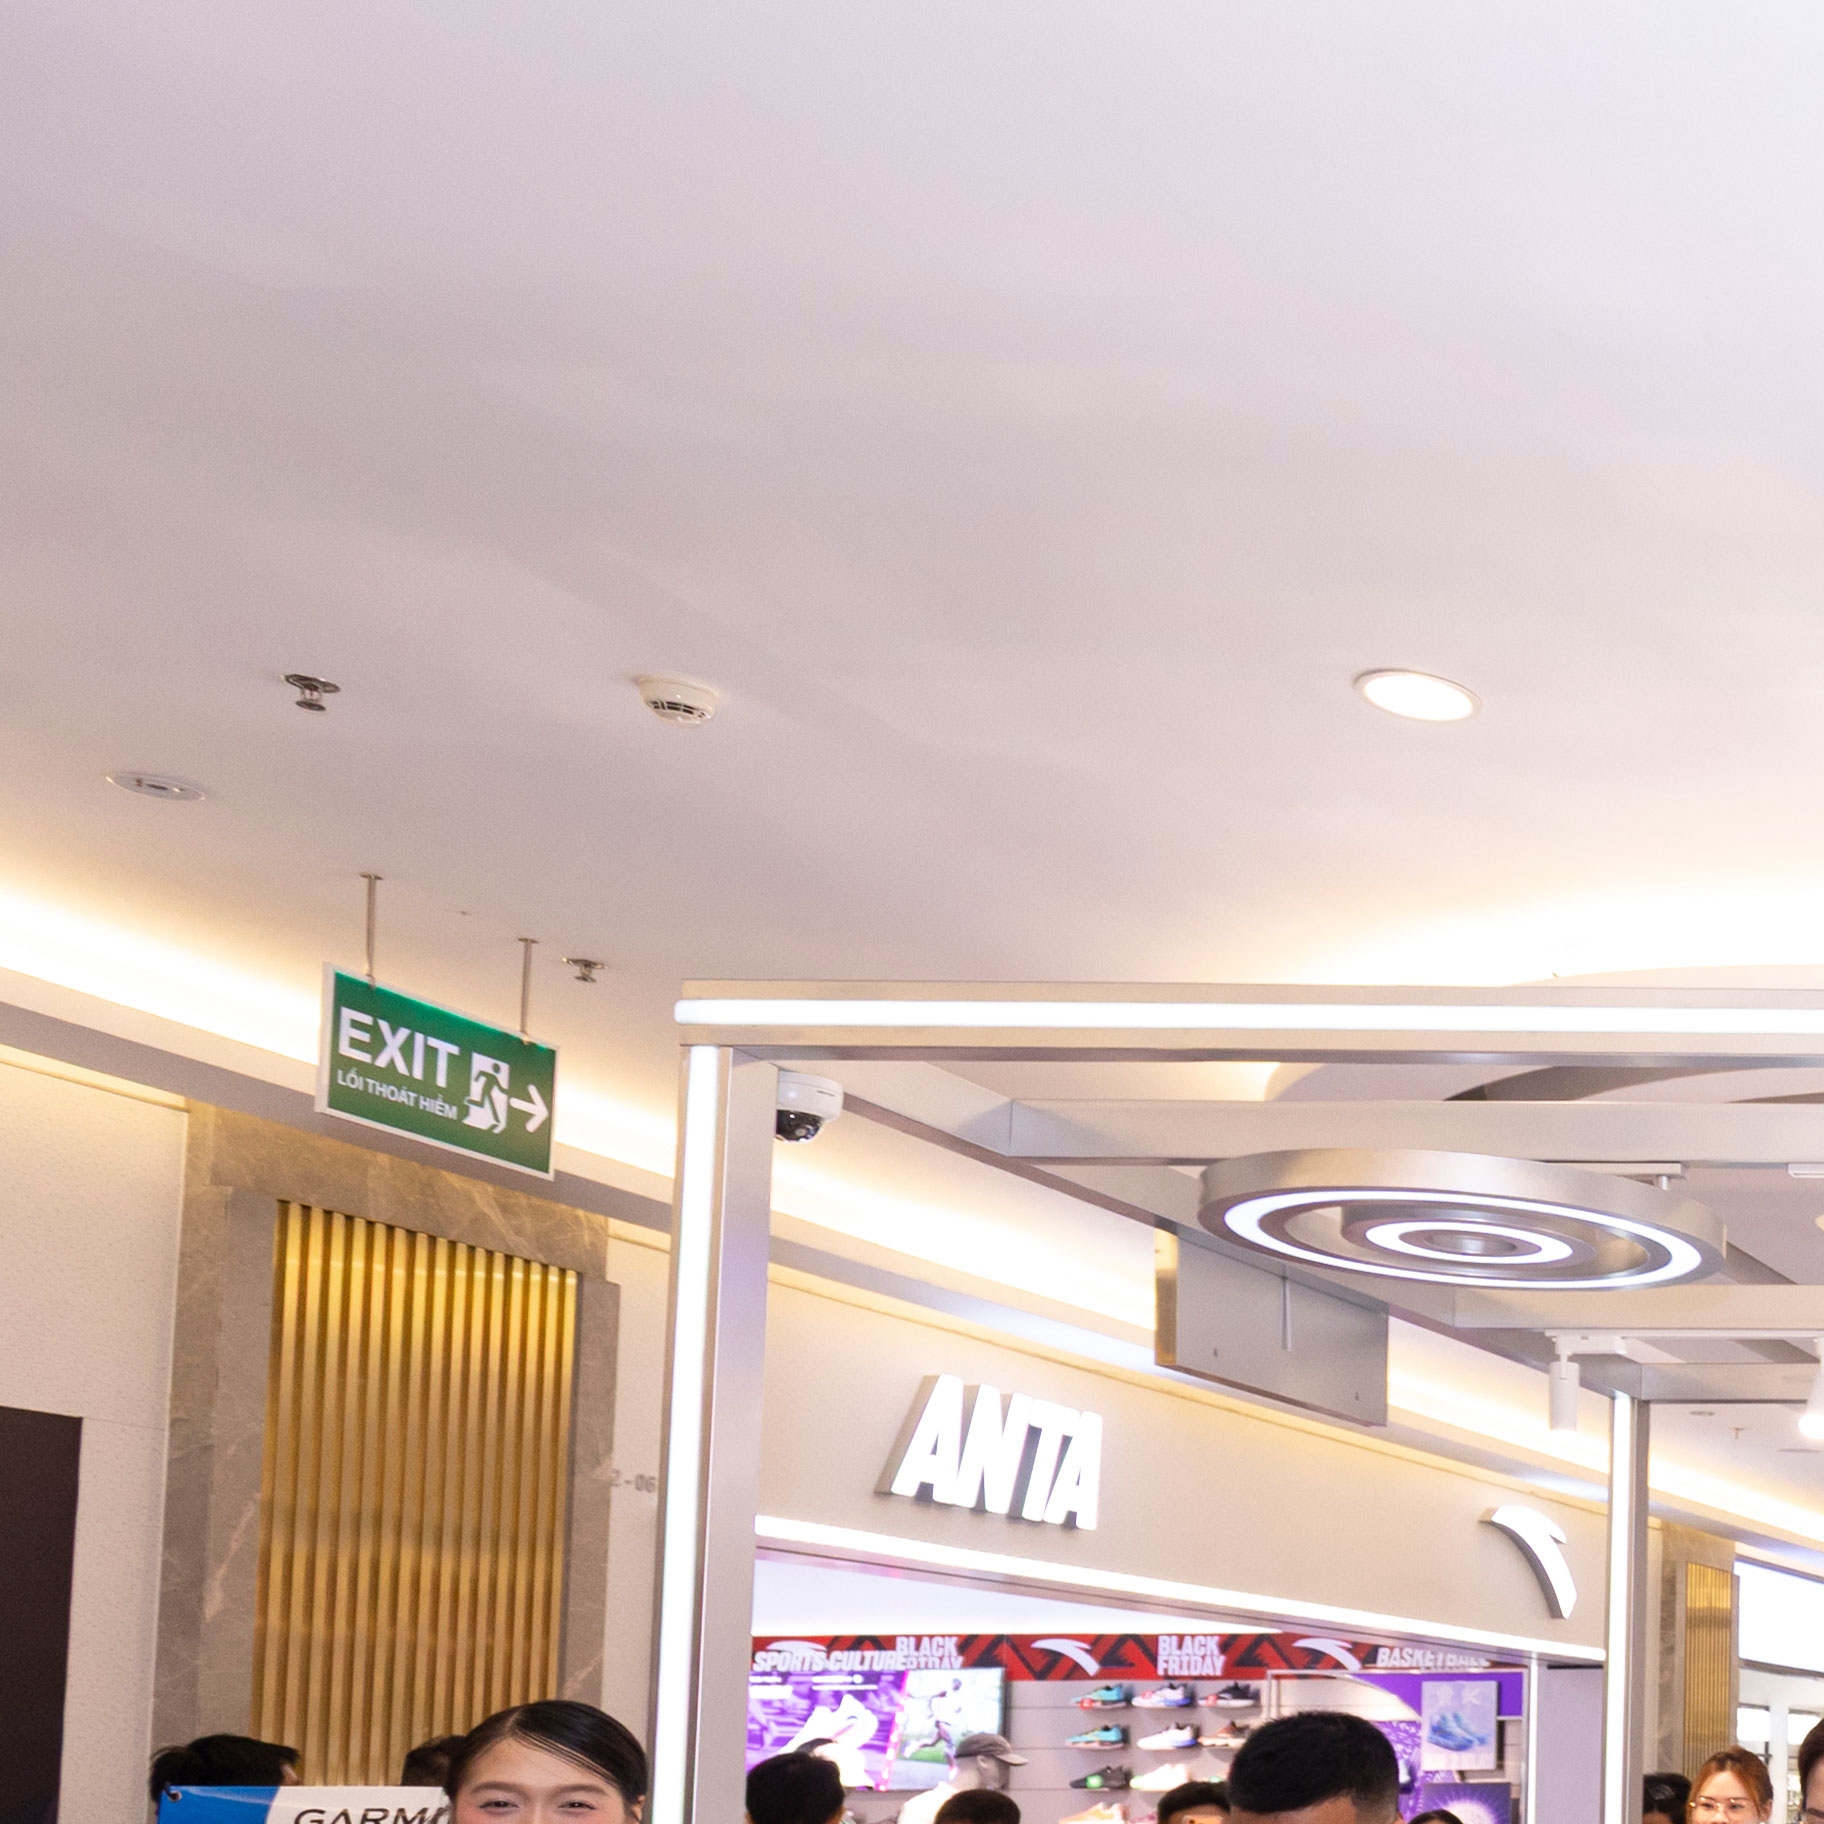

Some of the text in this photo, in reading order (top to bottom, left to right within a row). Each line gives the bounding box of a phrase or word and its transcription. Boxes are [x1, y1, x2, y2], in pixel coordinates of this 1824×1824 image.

[339, 1006, 460, 1088] EXIT
[367, 1079, 417, 1109] THOÁT
[890, 1373, 1104, 1532] ANTA
[896, 1636, 959, 1657] BLACK
[1157, 1635, 1220, 1656] BLACK
[752, 1650, 907, 1673] SPORTS CULTURE
[1157, 1655, 1225, 1677] FRIDAY
